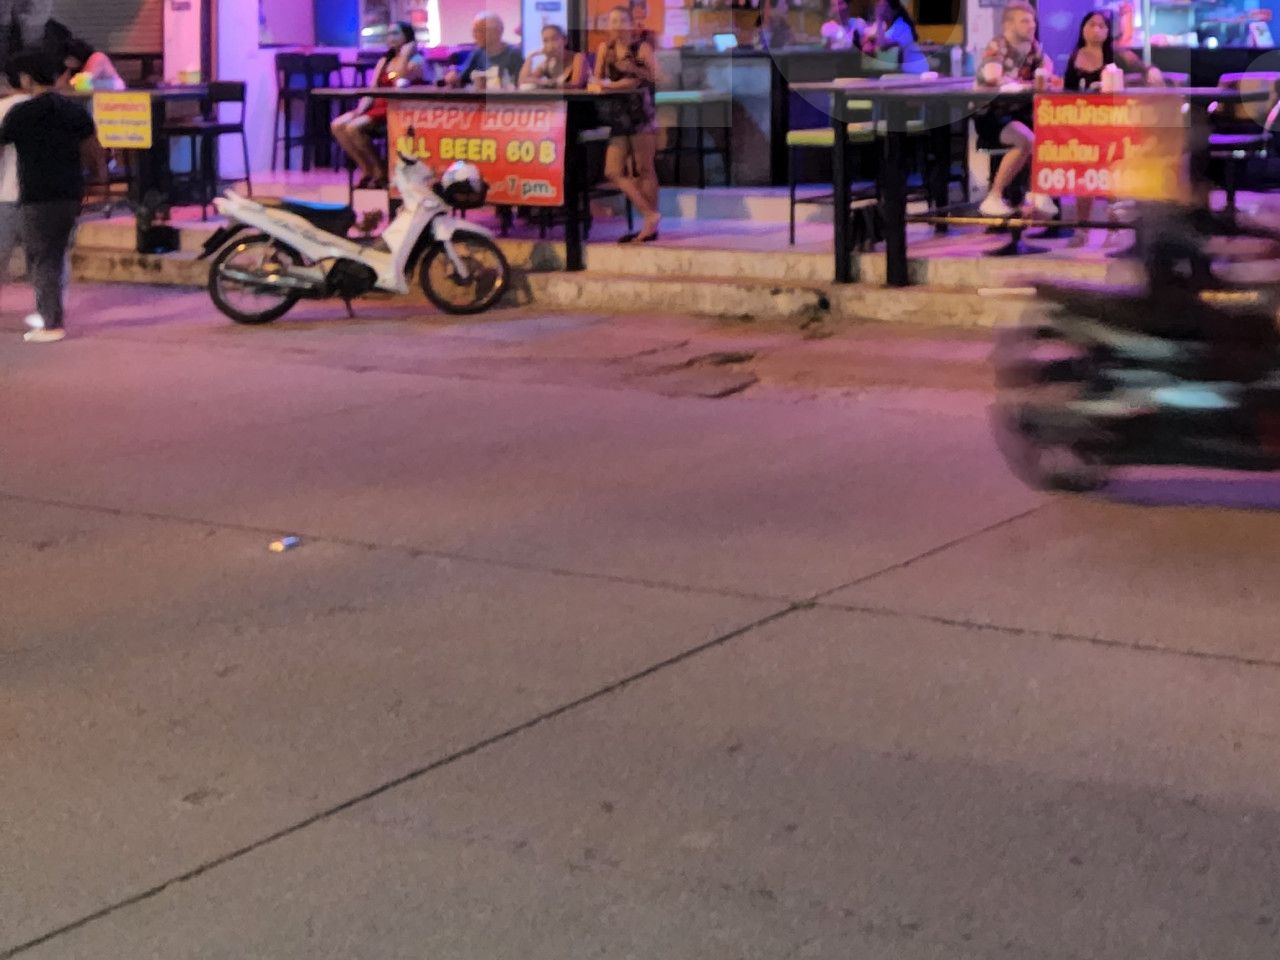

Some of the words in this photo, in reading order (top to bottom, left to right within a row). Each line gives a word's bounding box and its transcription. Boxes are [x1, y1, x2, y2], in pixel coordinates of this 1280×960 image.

[400, 105, 478, 129] HAPPY
[481, 106, 550, 131] HOUR
[439, 137, 497, 162] BEER
[506, 139, 535, 162] 60
